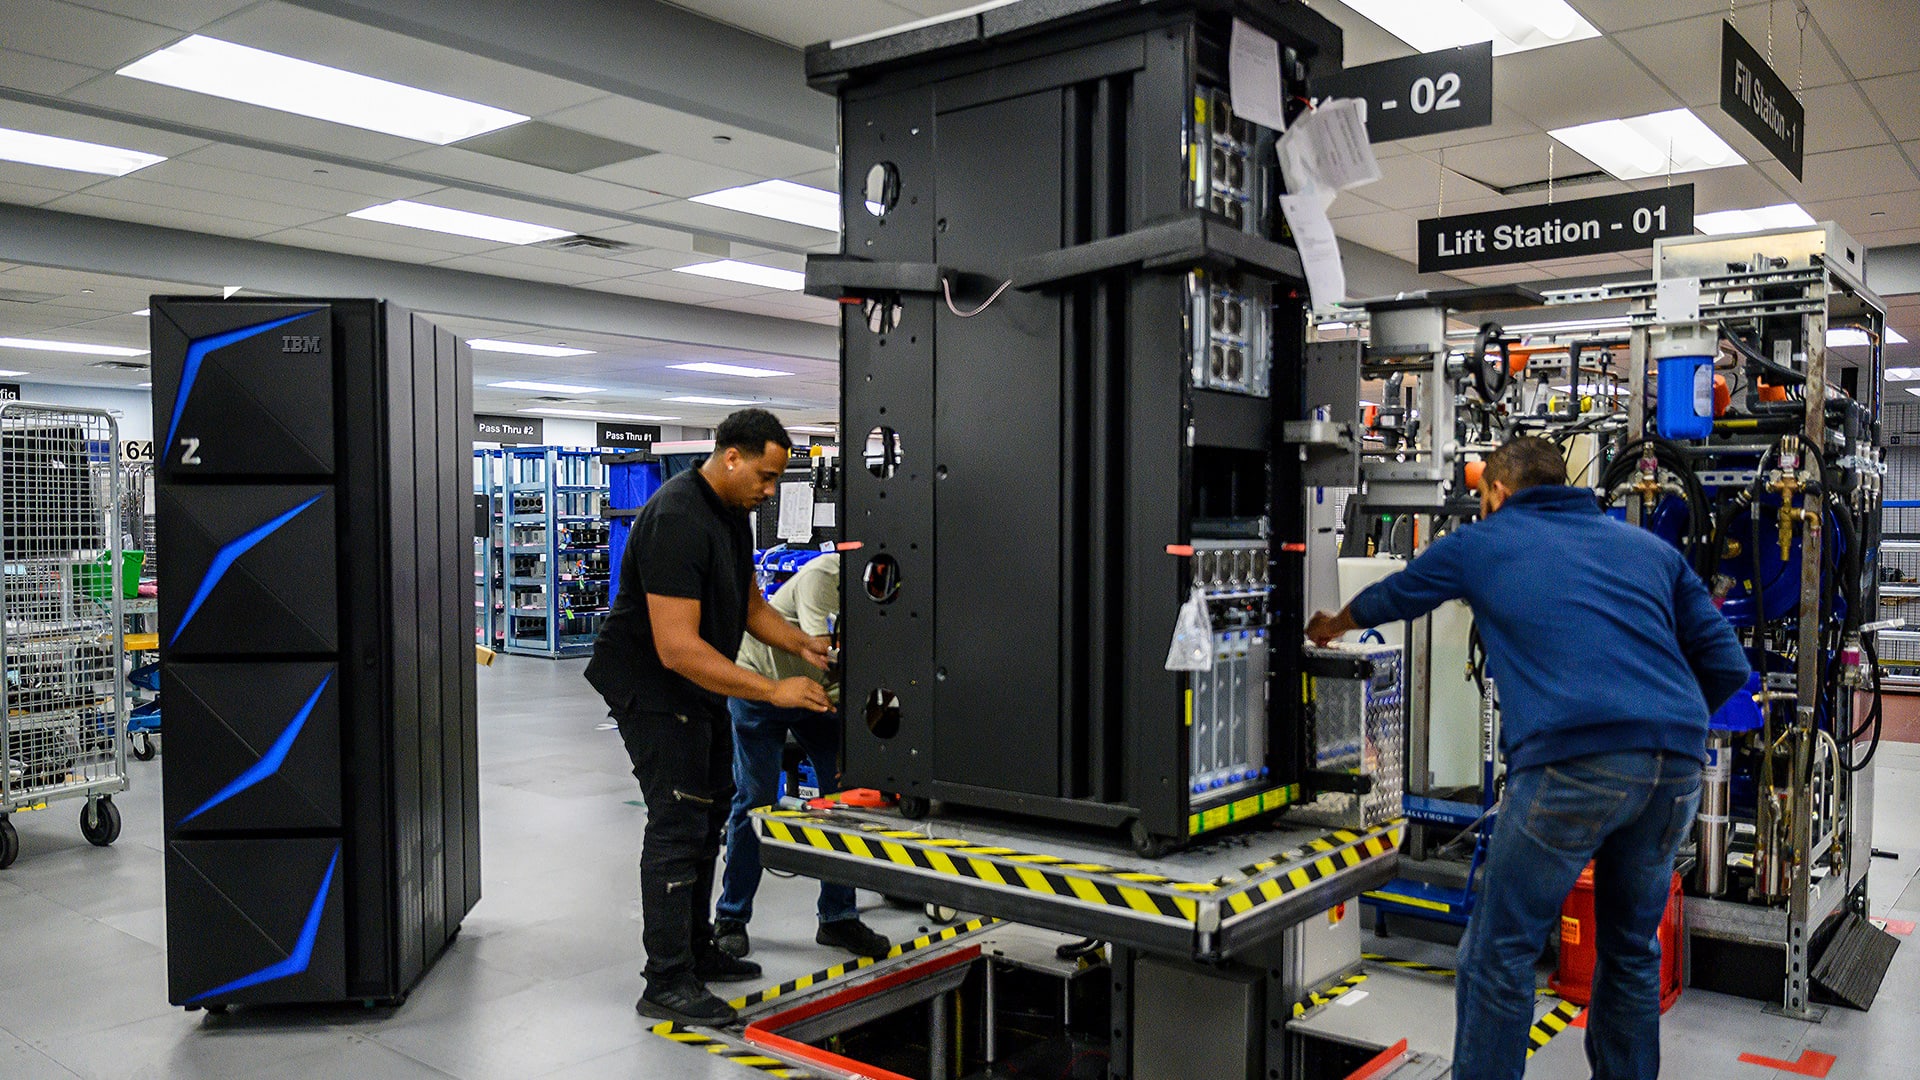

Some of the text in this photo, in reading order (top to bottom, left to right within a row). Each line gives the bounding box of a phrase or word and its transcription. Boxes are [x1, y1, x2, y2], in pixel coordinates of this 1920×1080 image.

[1410, 72, 1460, 114] 02
[1735, 58, 1751, 107] Fill
[1753, 78, 1785, 140] Station
[1792, 122, 1797, 153] 1
[1437, 205, 1667, 257] Lift Station - 01
[282, 335, 321, 353] IBM
[479, 423, 534, 435] Pass Thru #2
[605, 430, 652, 442] Pass Thru #1
